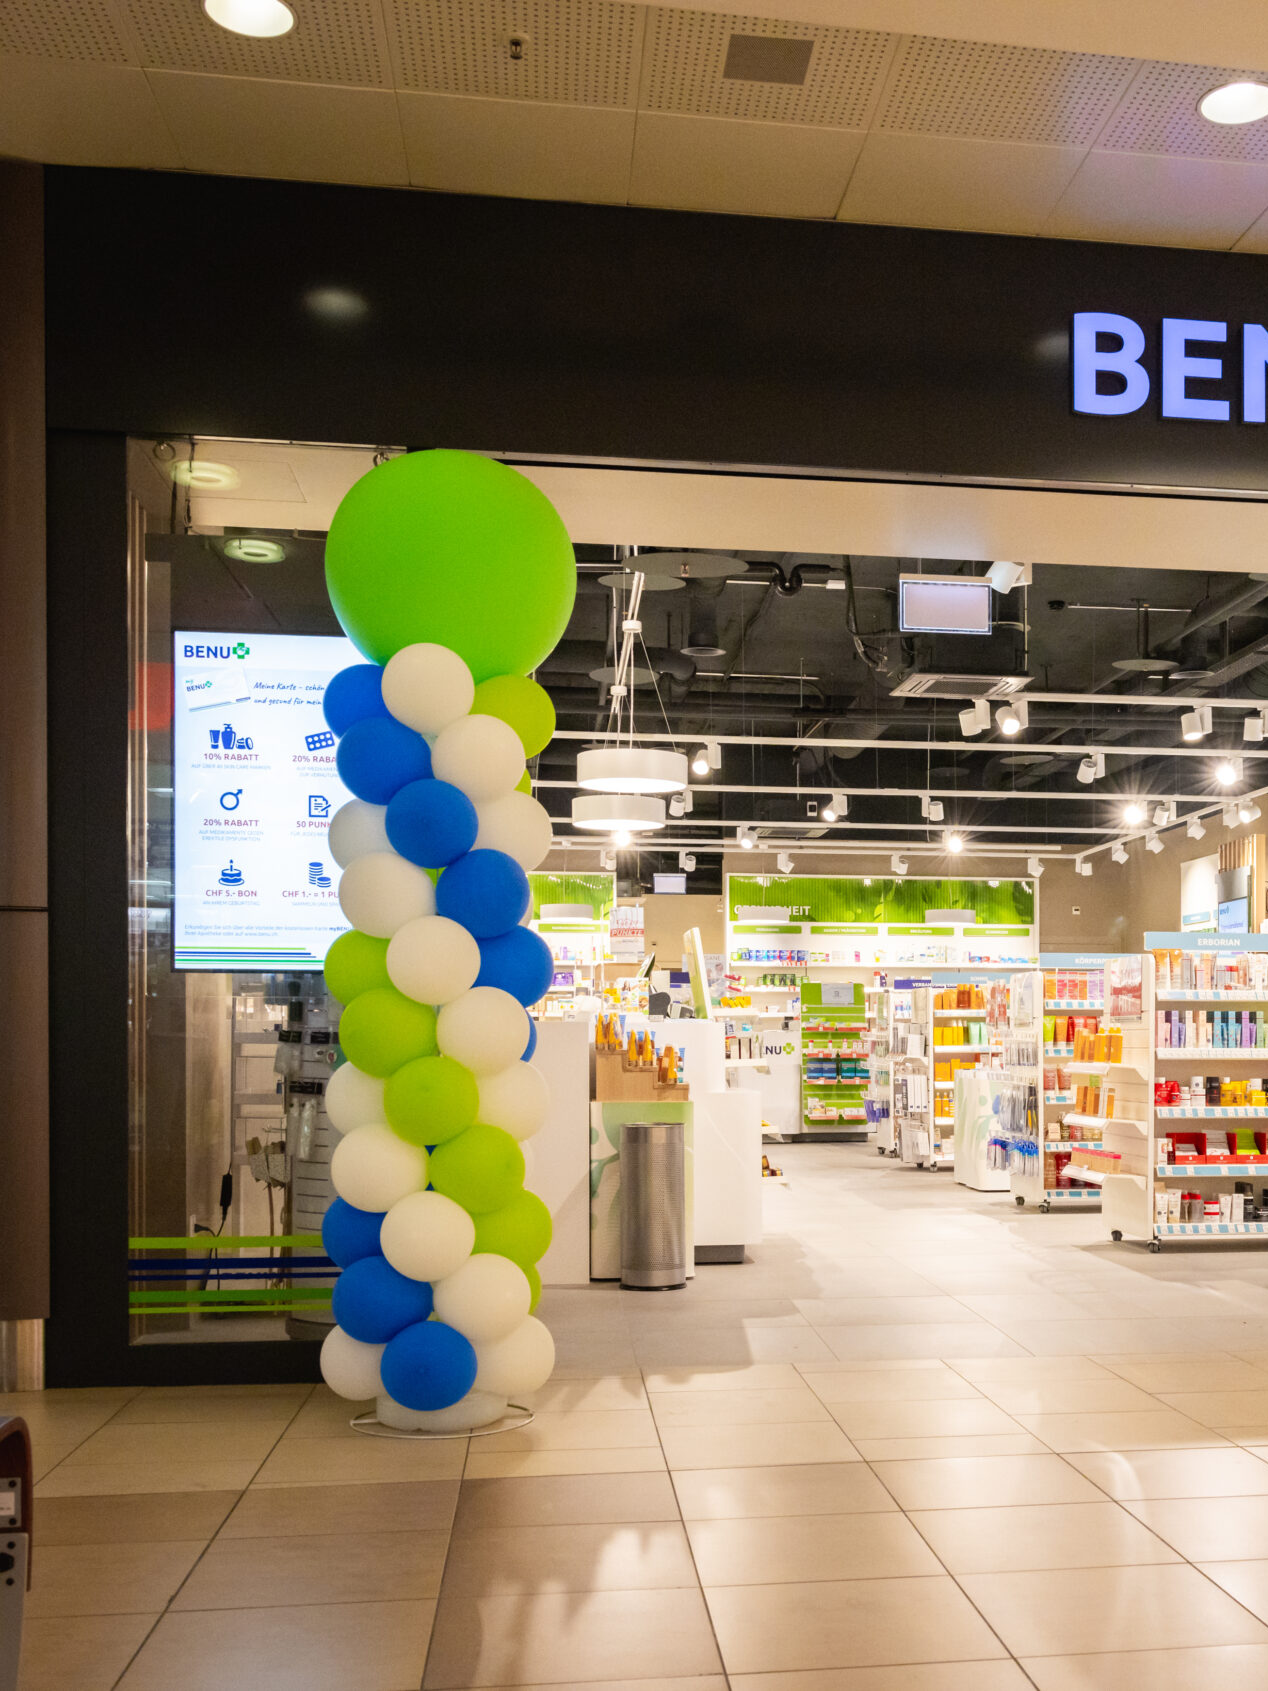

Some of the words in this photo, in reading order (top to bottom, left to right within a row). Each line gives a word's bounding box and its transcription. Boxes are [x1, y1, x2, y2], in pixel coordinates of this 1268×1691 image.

[184, 645, 231, 659] BENU
[187, 684, 206, 692] BENU
[253, 682, 275, 690] Meine
[276, 682, 297, 690] Karte
[305, 681, 325, 691] schön
[268, 697, 292, 706] gesund
[293, 697, 305, 706] für
[204, 753, 222, 761] 10%
[224, 753, 260, 761] RABATT
[291, 755, 310, 763] 20%
[203, 818, 222, 826] 20%
[224, 819, 260, 827] RABATT
[205, 889, 223, 897] CHF
[282, 890, 299, 898] CHF
[1197, 938, 1241, 947] ERBORIAN
